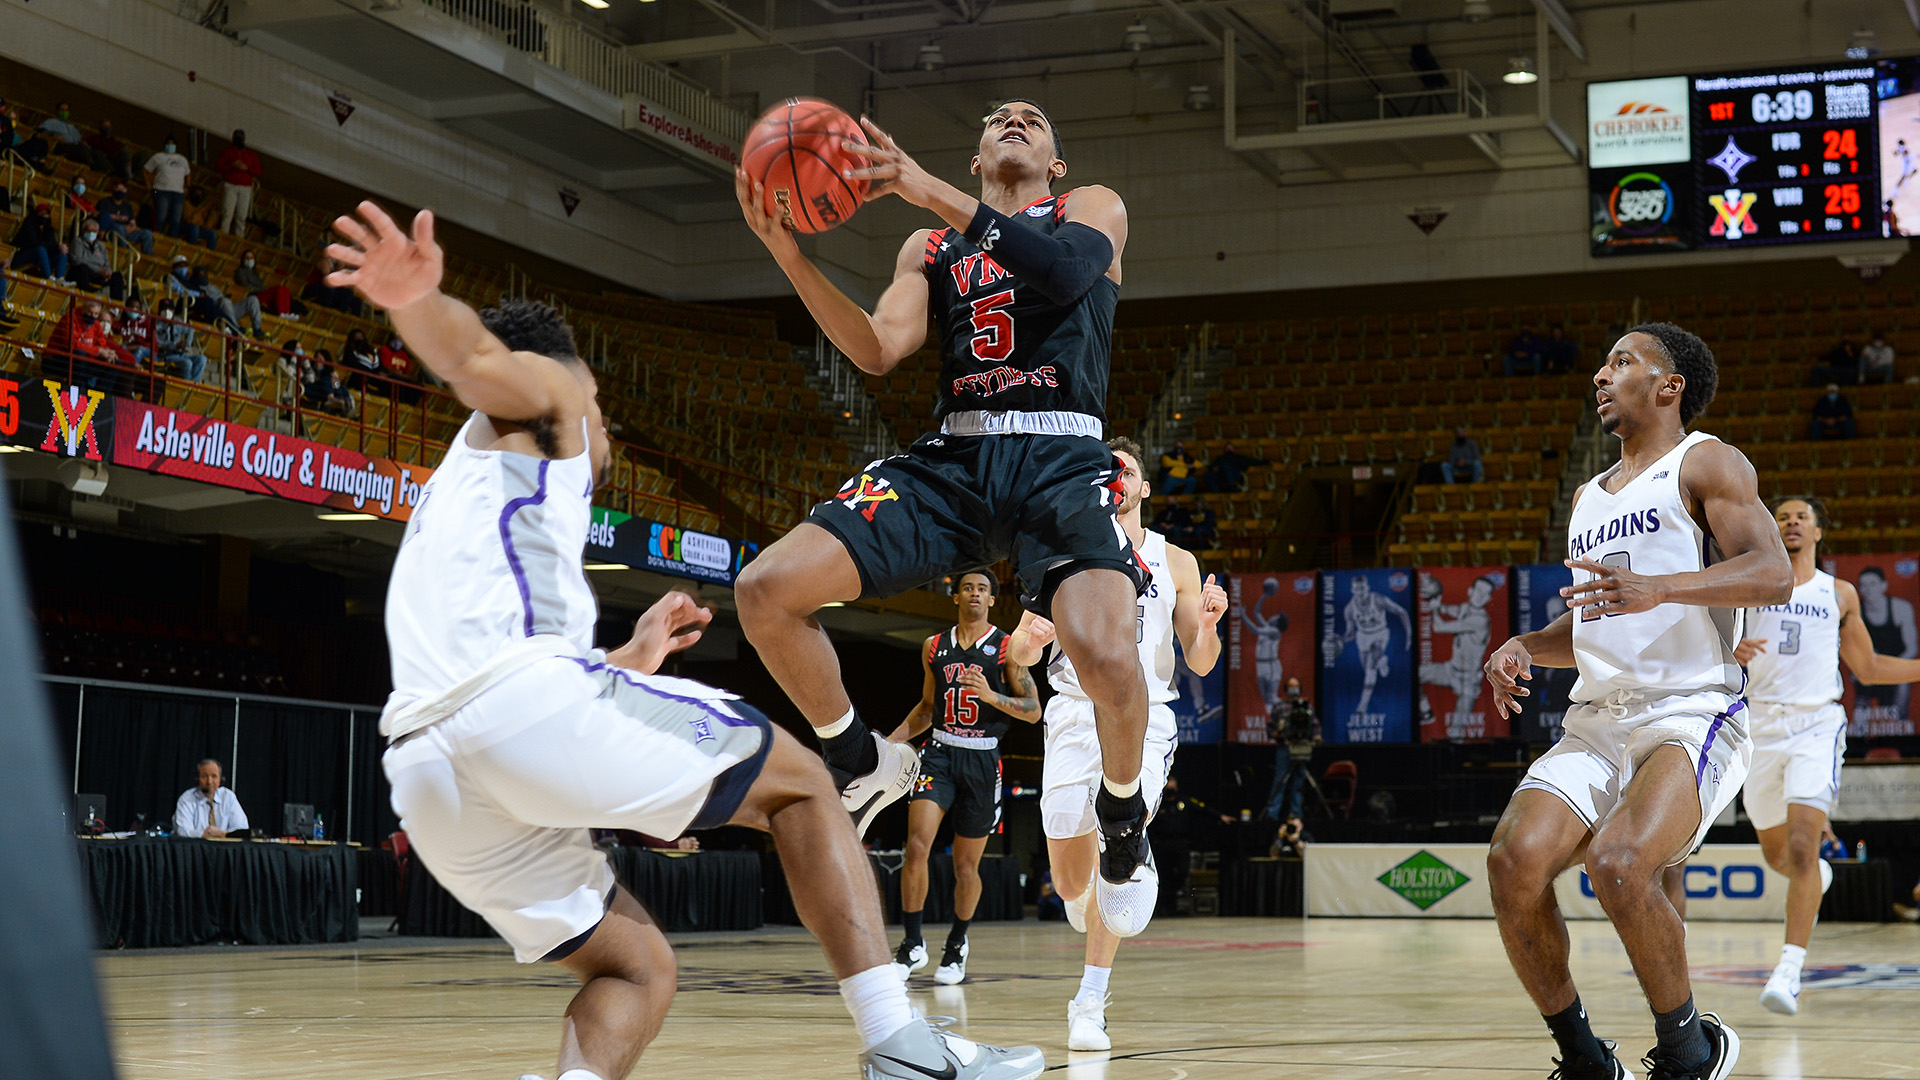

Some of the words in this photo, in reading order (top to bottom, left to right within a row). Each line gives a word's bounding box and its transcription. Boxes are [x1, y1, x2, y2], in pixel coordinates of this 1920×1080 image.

[1708, 102, 1735, 121] 1ST
[1752, 89, 1813, 123] 6:39
[1594, 115, 1684, 136] CHEROKEE
[1596, 139, 1628, 149] north
[1772, 131, 1801, 151] FUR
[1823, 129, 1858, 160] 24
[1824, 183, 1860, 215] 25
[1617, 199, 1665, 222] 360
[950, 251, 1015, 296] VM
[970, 288, 1015, 361] 5
[136, 410, 235, 470] Asheville
[241, 434, 295, 481] Color
[299, 448, 314, 487] &
[320, 451, 394, 515] Imaging
[687, 536, 726, 554] ASHEVILLE
[1570, 508, 1660, 562] PALADINS
[1779, 620, 1801, 655] 3
[944, 687, 979, 725] 15
[1245, 715, 1266, 728] VAL
[1347, 713, 1386, 727] JERRY
[1237, 729, 1268, 743] WHIT
[1349, 728, 1384, 742] WEST
[1389, 867, 1457, 889] HOLSTON
